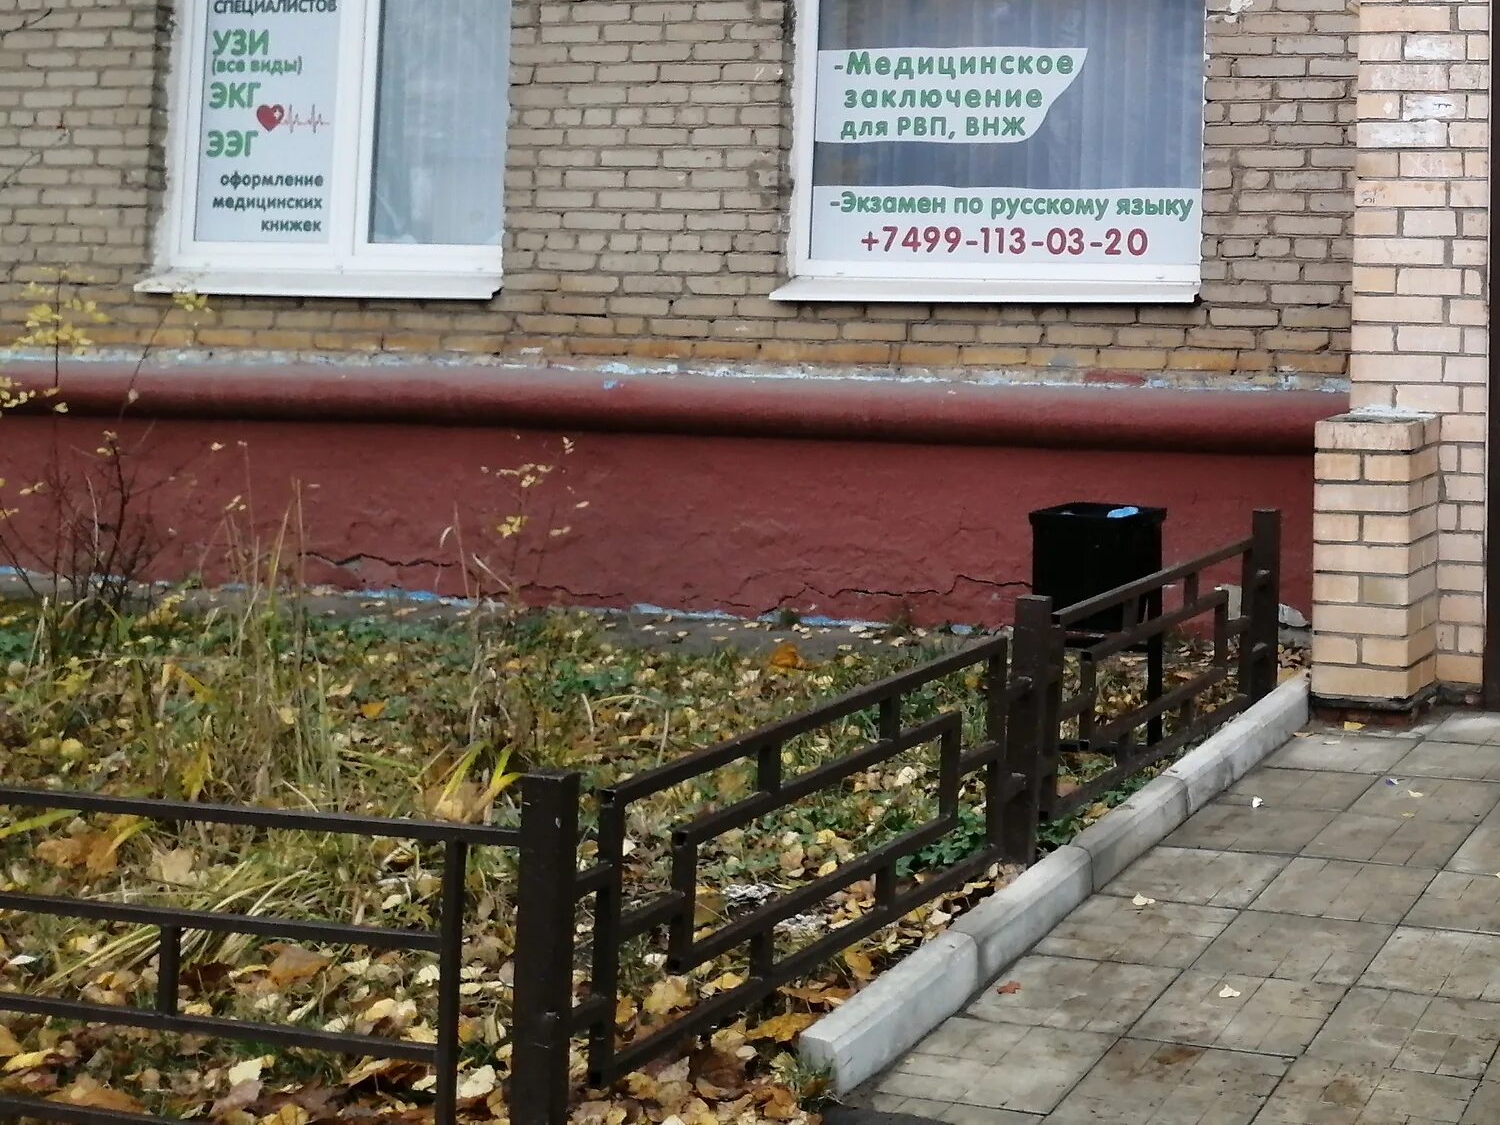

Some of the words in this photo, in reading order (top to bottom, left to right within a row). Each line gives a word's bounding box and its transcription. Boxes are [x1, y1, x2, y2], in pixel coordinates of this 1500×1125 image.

[212, 28, 269, 56] УЗИ
[212, 56, 246, 75] (все
[250, 55, 303, 75] виды)
[834, 51, 1074, 80] -Медицинское
[209, 81, 261, 109] ЭКГ
[844, 87, 1043, 109] заключение
[840, 119, 888, 140] для
[897, 115, 955, 140] РВП,
[965, 115, 1026, 137] ВНЖ
[205, 130, 259, 158] ЭЭГ
[220, 172, 324, 189] оформление
[212, 196, 323, 211] медицинских
[829, 190, 944, 214] -Экзамен
[954, 197, 984, 214] по
[991, 196, 1109, 221] русскому
[1116, 197, 1194, 221] языку
[260, 217, 322, 233] книжек
